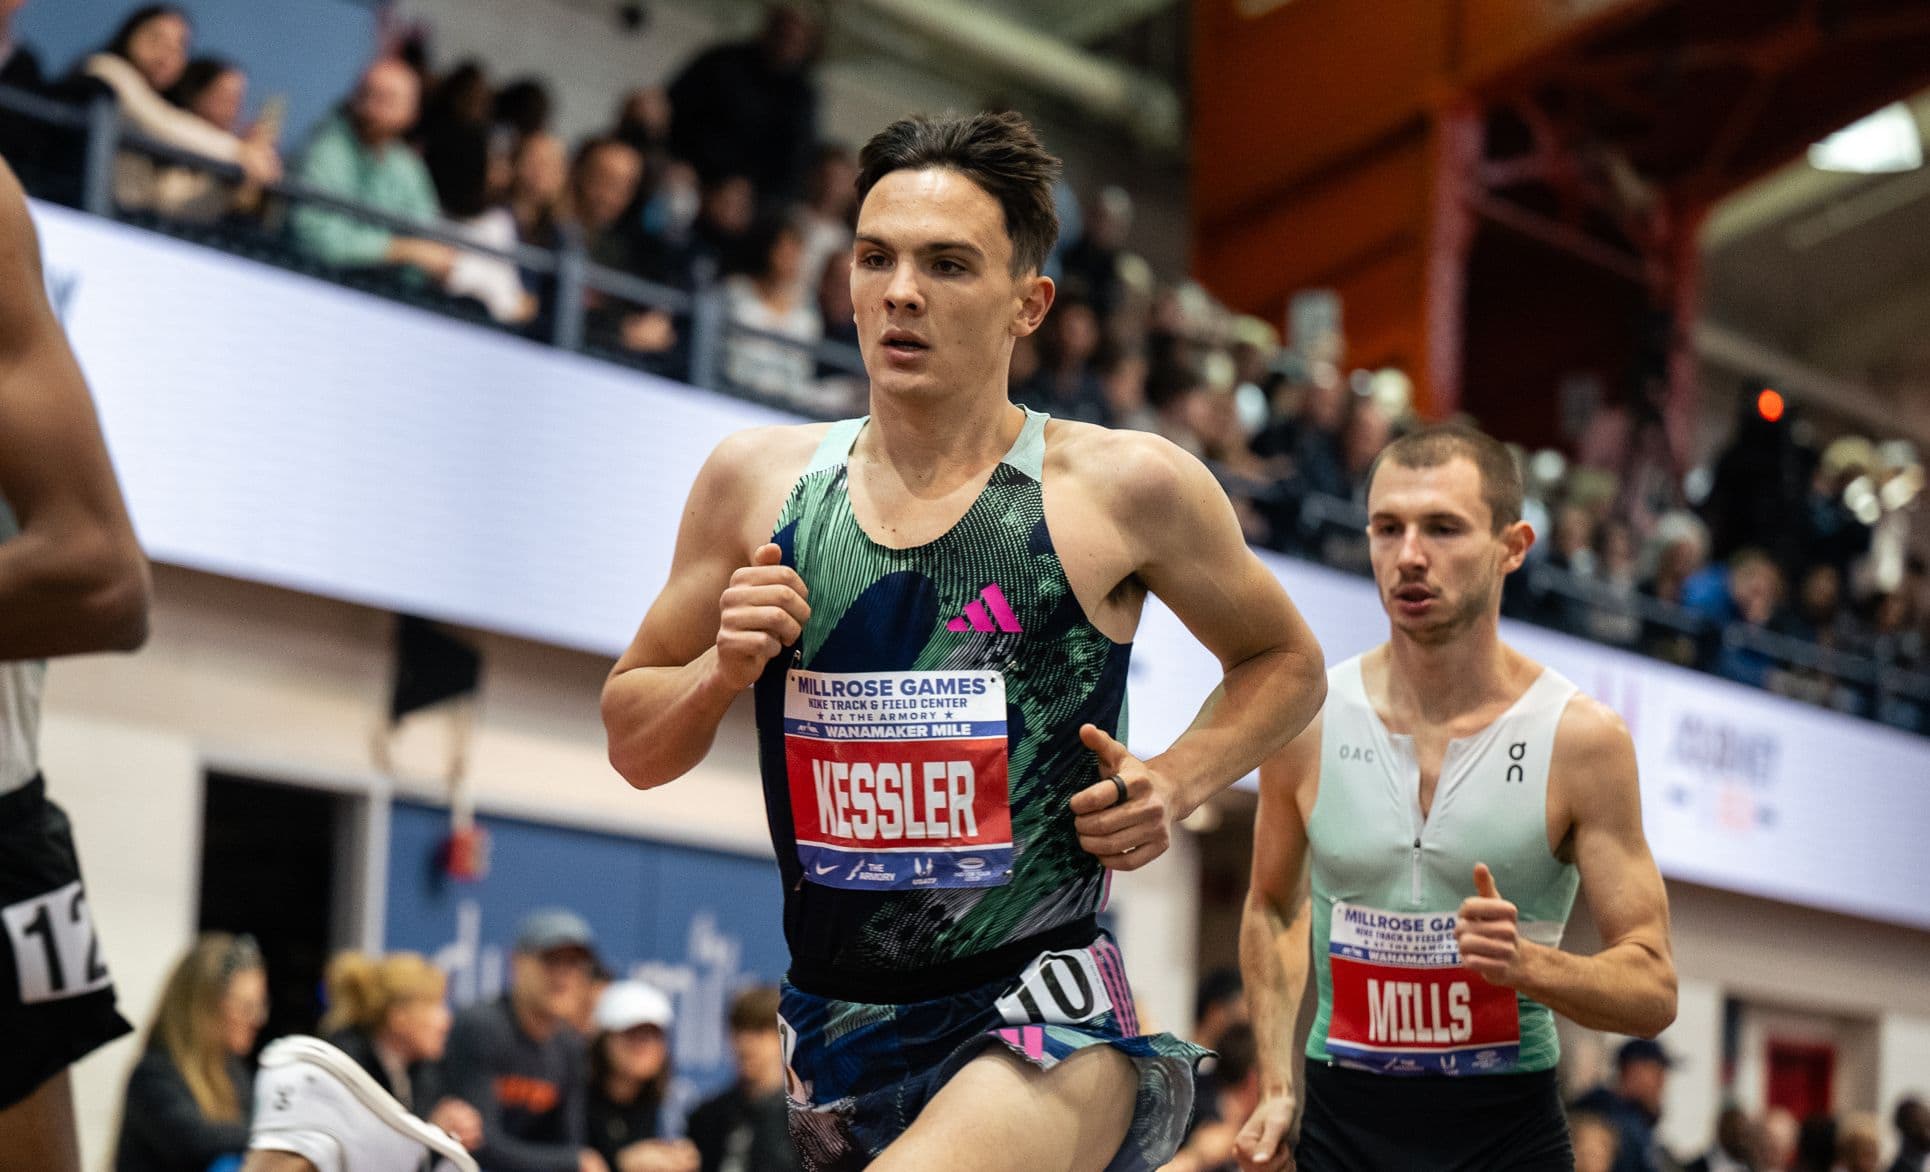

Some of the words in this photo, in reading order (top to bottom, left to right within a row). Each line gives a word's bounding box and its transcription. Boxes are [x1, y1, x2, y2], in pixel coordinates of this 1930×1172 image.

[798, 676, 894, 698] MILLROSE
[900, 677, 986, 695] GAMES
[808, 698, 829, 710] NIKE
[831, 699, 868, 711] TRACK
[871, 699, 878, 710] &
[882, 698, 917, 710] FIELD
[920, 697, 968, 709] CENTER
[830, 712, 843, 722] AT
[849, 712, 874, 722] THE
[880, 711, 937, 721] ARMORY
[825, 724, 929, 738] WANAMAKER
[932, 723, 971, 737] MILE
[1339, 745, 1375, 763] OAC
[812, 758, 979, 840] KESSLER
[1345, 908, 1424, 932] MILLROSE
[1430, 917, 1456, 932] GA
[1001, 953, 1095, 1023] 10
[1366, 978, 1473, 1044] MILLS
